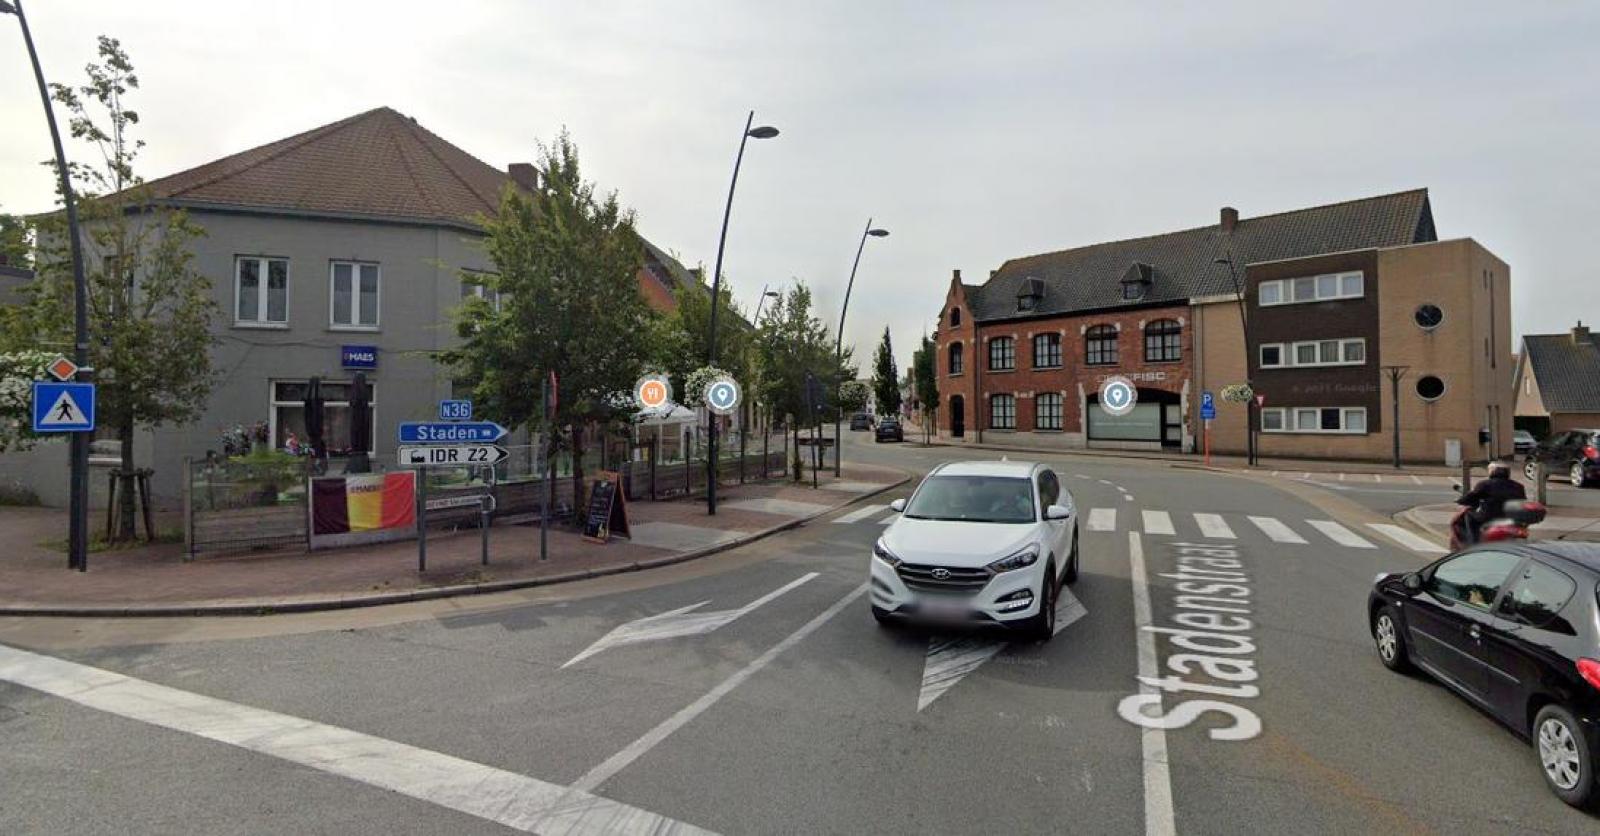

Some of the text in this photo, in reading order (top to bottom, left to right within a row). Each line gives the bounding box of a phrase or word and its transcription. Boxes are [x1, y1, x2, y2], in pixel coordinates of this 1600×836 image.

[443, 403, 469, 417] N36
[417, 425, 477, 440] Staden
[430, 449, 488, 462] IDR Z2
